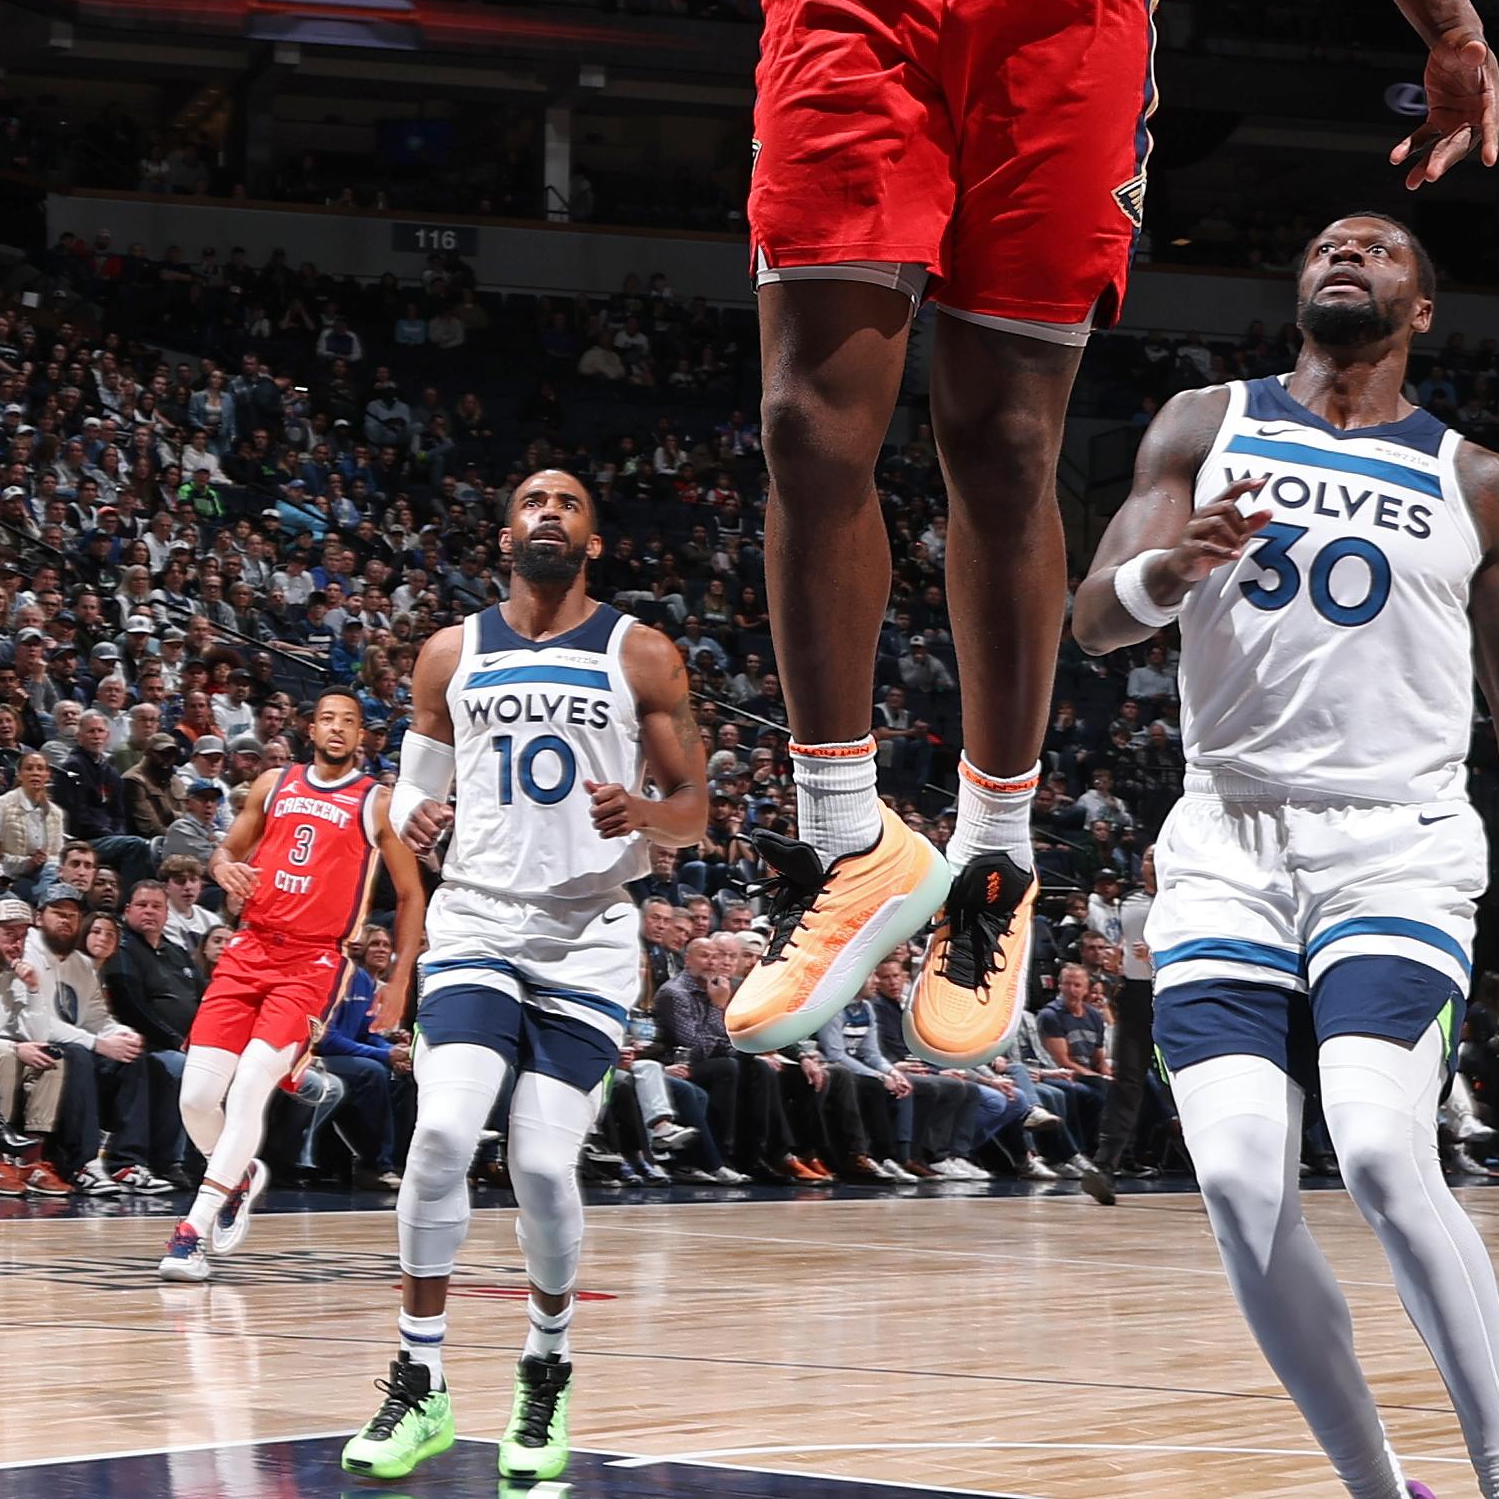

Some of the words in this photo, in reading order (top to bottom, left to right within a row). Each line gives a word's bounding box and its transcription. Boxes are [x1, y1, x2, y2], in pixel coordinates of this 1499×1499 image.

[413, 228, 458, 252] 116
[1385, 448, 1430, 467] sezzle
[1223, 467, 1432, 539] WOLVES
[1239, 521, 1392, 628] 30
[463, 694, 611, 730] WOLVES
[491, 735, 577, 806] 10
[274, 796, 352, 831] CRESCENT
[288, 825, 316, 866] 3
[274, 869, 313, 895] CITY
